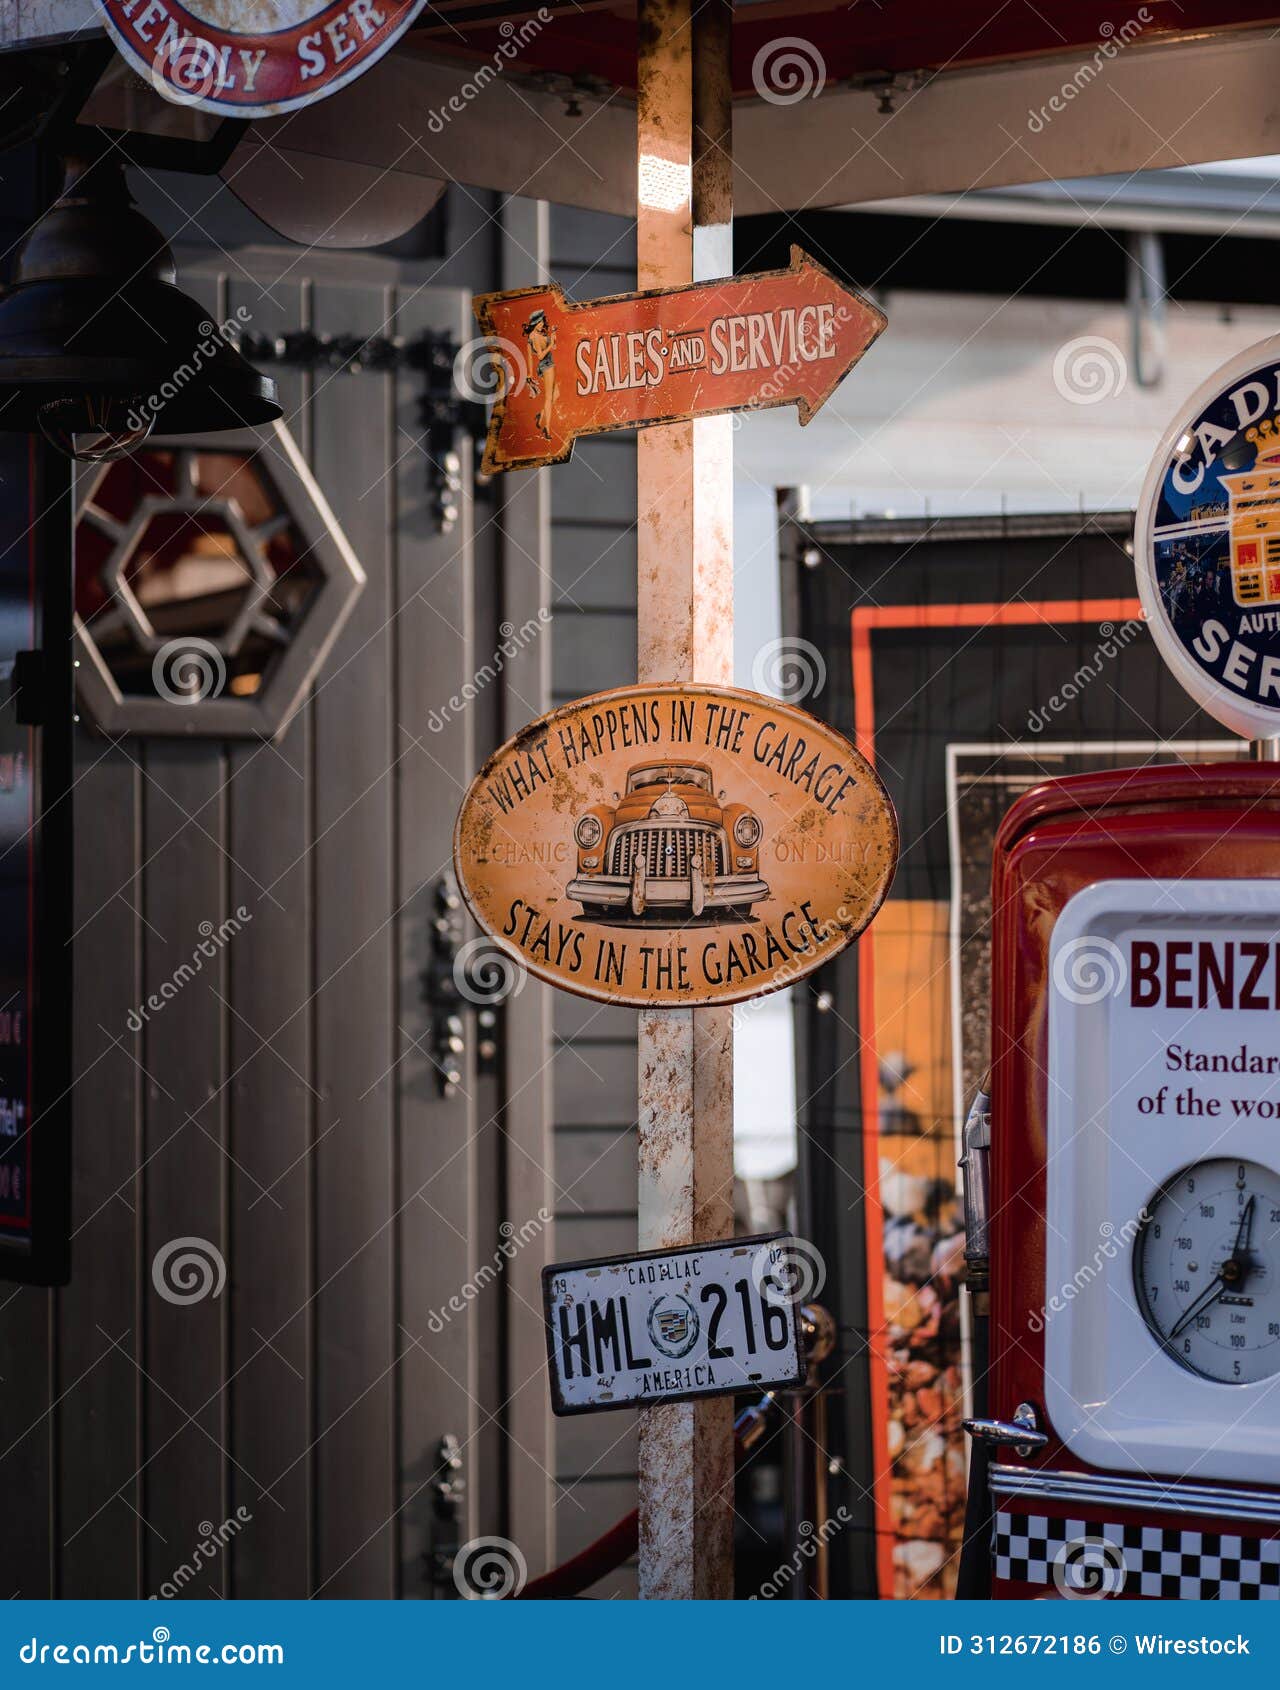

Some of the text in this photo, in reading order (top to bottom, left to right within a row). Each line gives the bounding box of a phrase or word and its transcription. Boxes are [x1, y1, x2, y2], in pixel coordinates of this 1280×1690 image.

[576, 303, 836, 396] SALES AND SERVICE
[486, 700, 858, 815] WHAT HAPPENS IN THE GARAGE
[775, 840, 804, 862] ON
[815, 841, 871, 862] DUTY
[503, 900, 830, 990] STAYS IN THE GARAGE
[1166, 1044, 1280, 1074] Standar
[1137, 1086, 1168, 1115] of
[1175, 1088, 1221, 1116] the
[1238, 1165, 1245, 1180] 0
[1187, 1179, 1195, 1193] 9
[1200, 1205, 1215, 1218] 180
[1154, 1225, 1161, 1239] 8
[1178, 1238, 1192, 1250] 160
[628, 1259, 702, 1285] CADILLAC
[554, 1279, 567, 1294] 19
[1175, 1280, 1190, 1292] 140
[1151, 1287, 1158, 1301] 7
[559, 1275, 790, 1379] HML 216
[1196, 1316, 1211, 1328] 120
[1268, 1323, 1280, 1336] 80
[1184, 1338, 1191, 1353] 6
[1230, 1335, 1245, 1347] 100
[1233, 1361, 1241, 1376] 5
[642, 1366, 716, 1394] AMERICA
